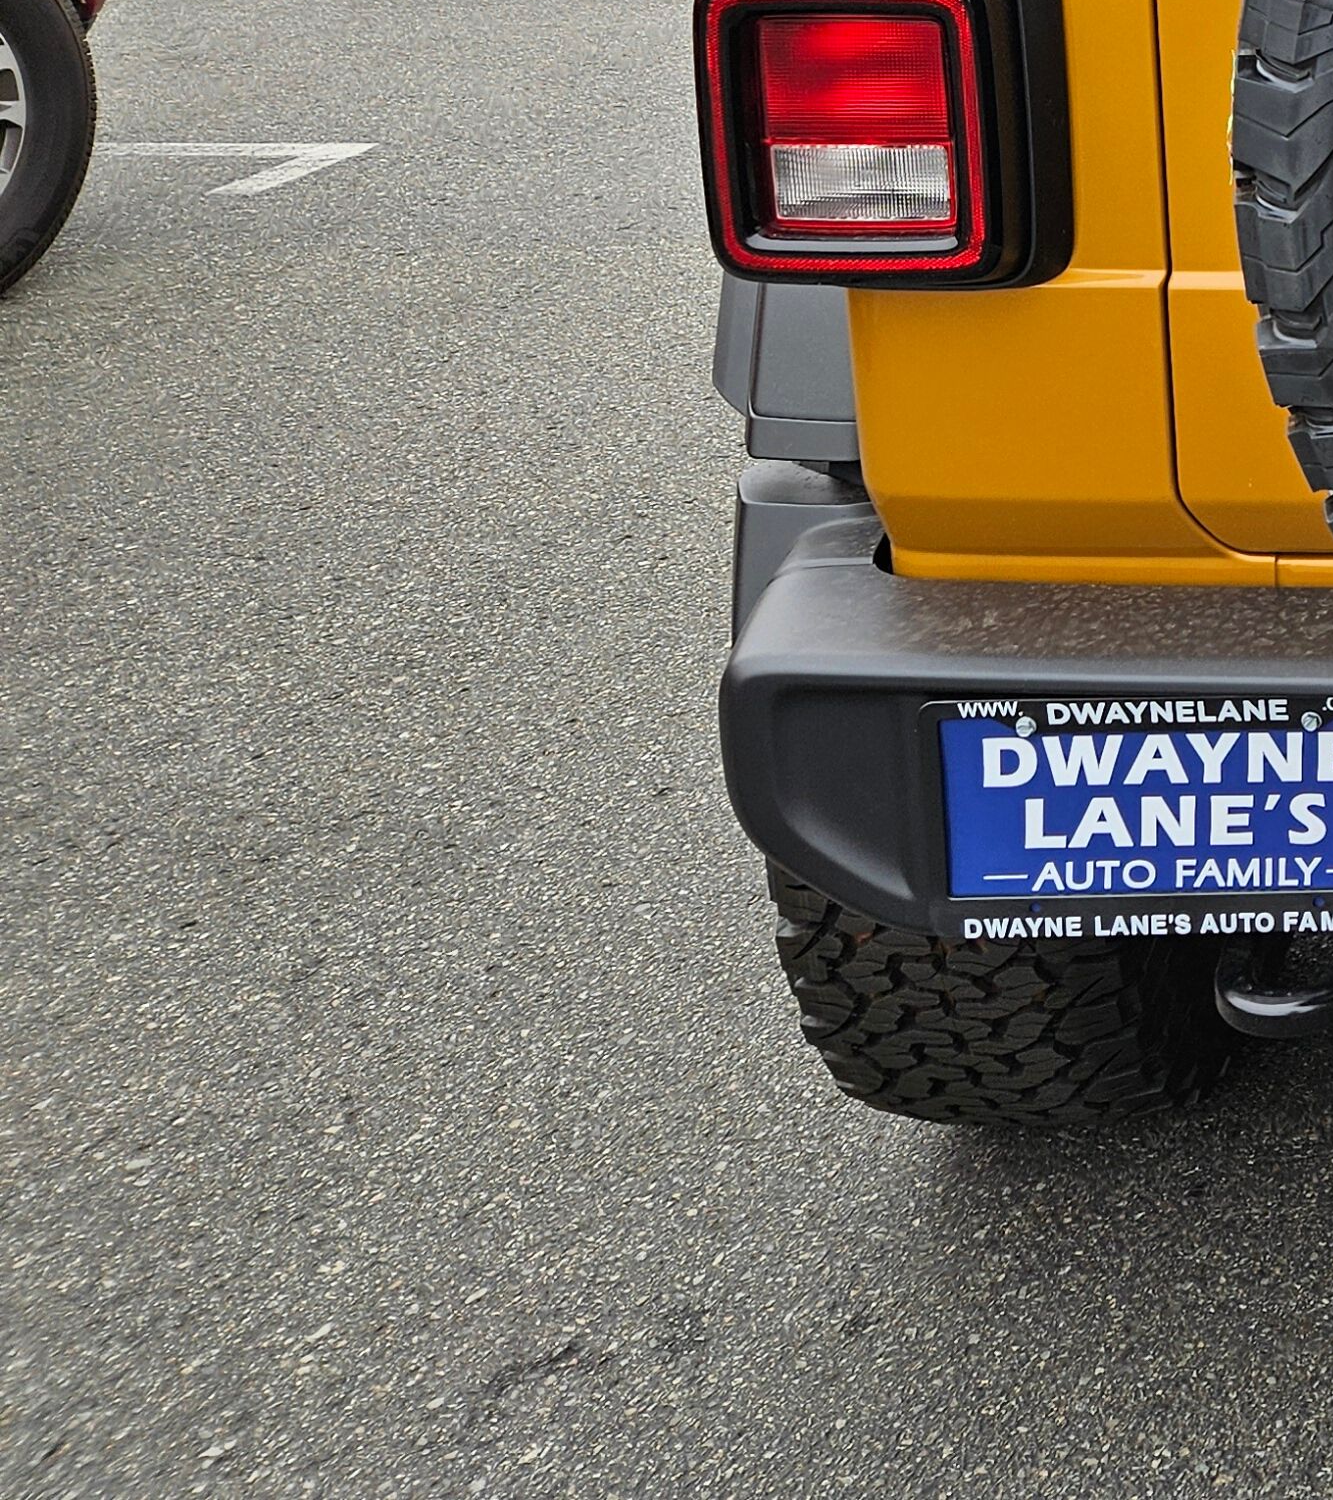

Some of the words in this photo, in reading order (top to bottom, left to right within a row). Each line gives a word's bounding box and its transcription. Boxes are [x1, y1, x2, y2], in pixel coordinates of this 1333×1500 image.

[956, 701, 1024, 719] WWW.
[1046, 699, 1290, 726] DWAYNELANE
[1023, 792, 1328, 850] LANE'S
[1031, 859, 1157, 893] AUTO
[1174, 856, 1323, 888] FAMILY
[963, 914, 1083, 940] DWAYNE
[1094, 912, 1192, 937] LANE'S
[1200, 911, 1275, 936] AUTO
